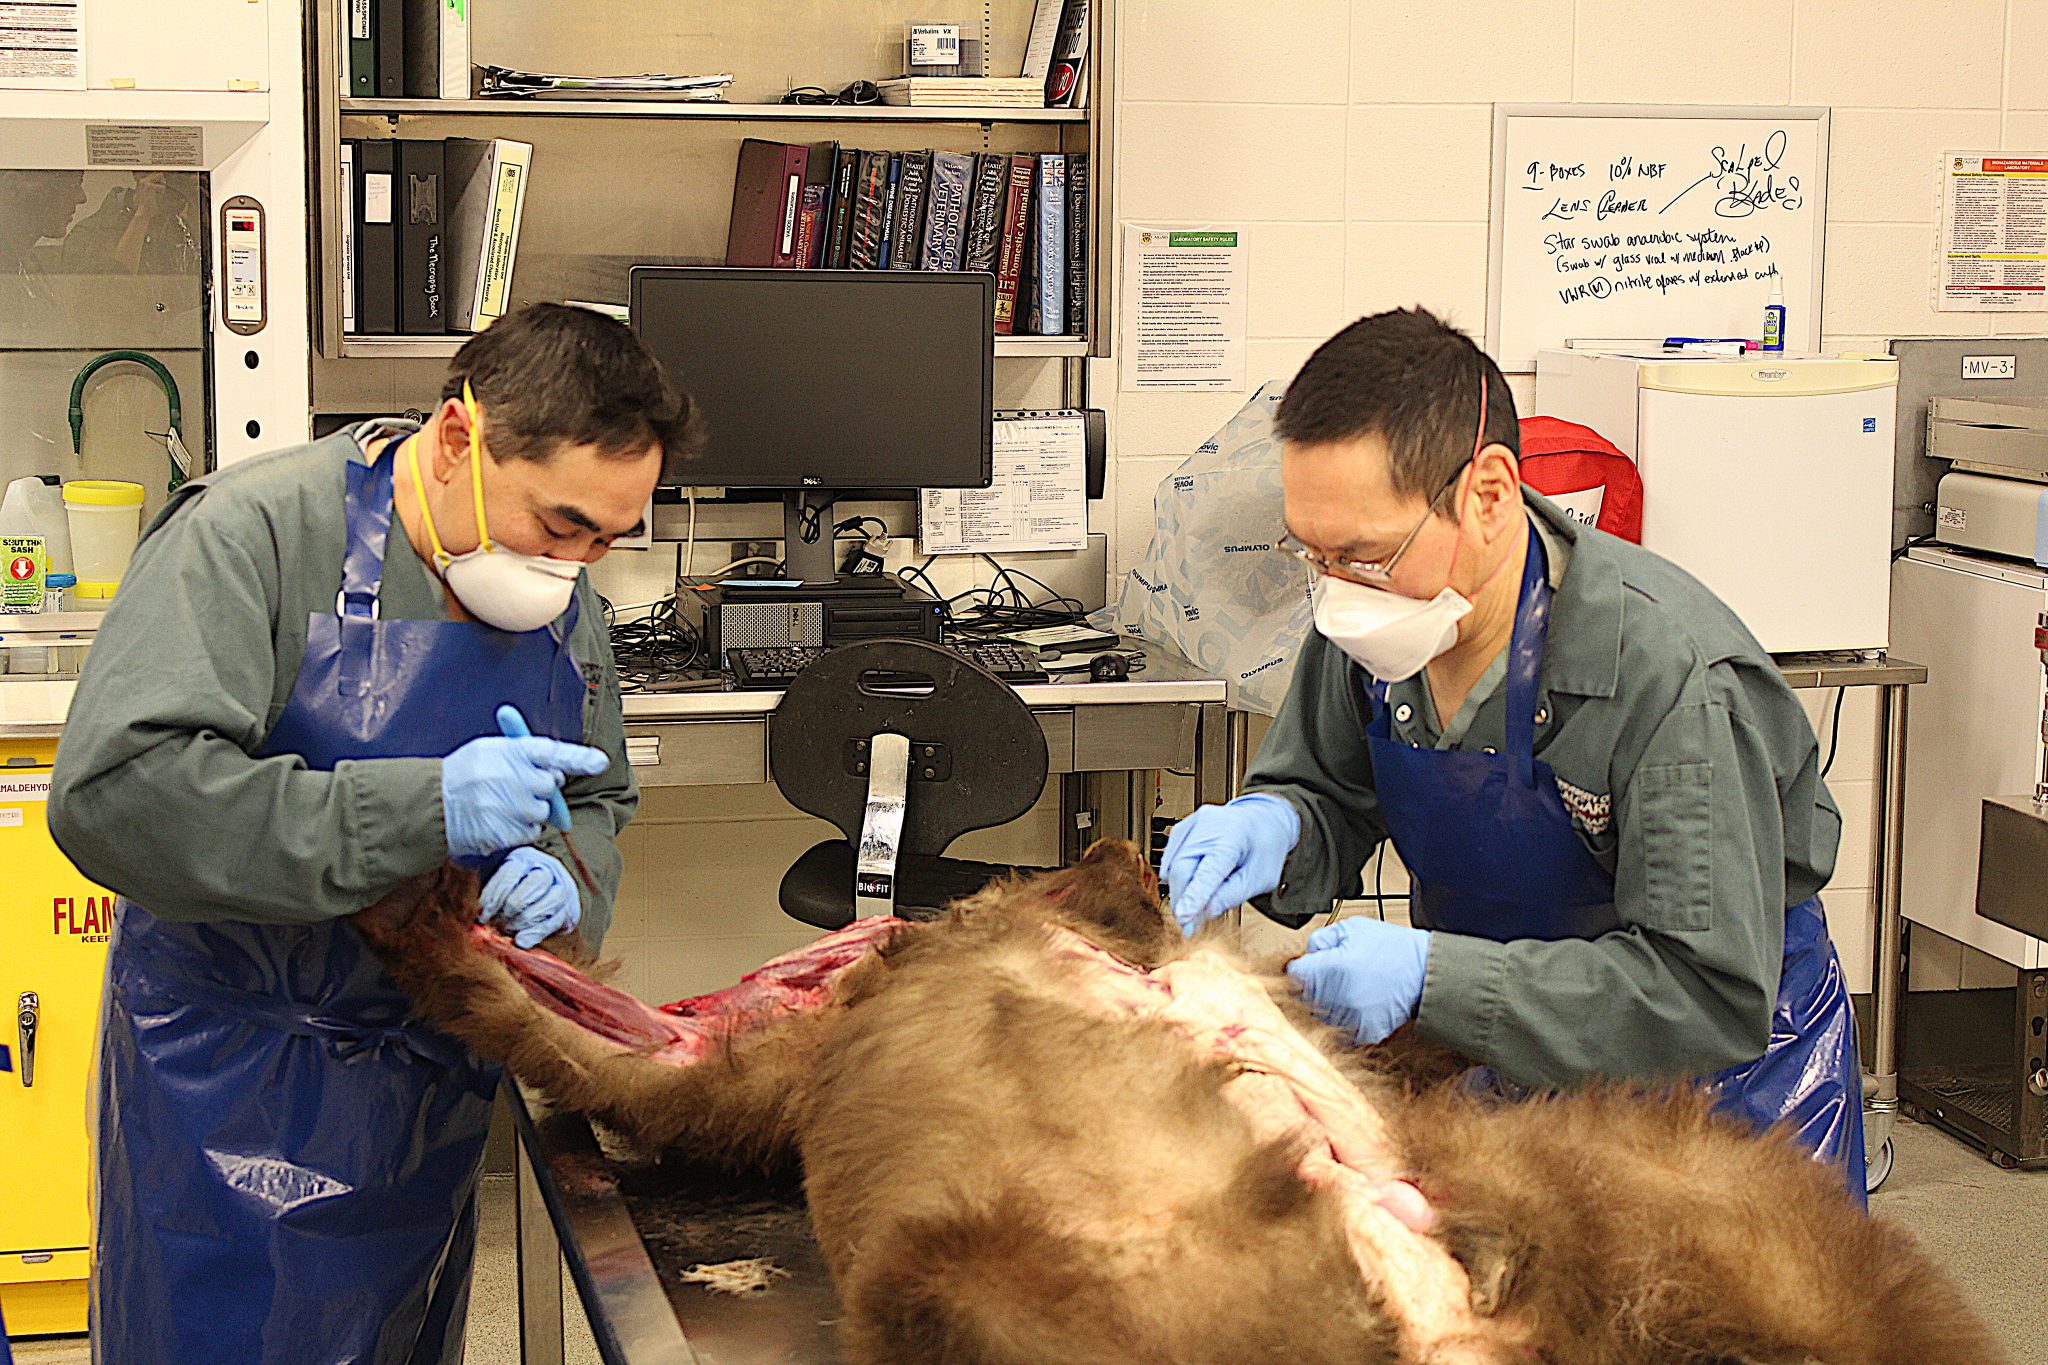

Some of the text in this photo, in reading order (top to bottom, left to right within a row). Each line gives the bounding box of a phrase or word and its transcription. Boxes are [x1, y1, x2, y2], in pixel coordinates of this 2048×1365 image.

[1609, 156, 1632, 181] 10%
[1638, 163, 1667, 178] NBF
[901, 194, 911, 229] DOMESTIC
[907, 195, 918, 234] PATHOLOGY
[931, 182, 950, 254] VETERINARY
[943, 183, 962, 259] PATHOLOGIC
[884, 220, 892, 241] MANUAL
[1010, 231, 1024, 277] Domestic
[1017, 188, 1030, 230] Animals
[1543, 231, 1576, 254] Star
[1581, 233, 1620, 249] swab
[897, 229, 906, 258] ANIMALS
[1000, 242, 1011, 276] Anatomy
[1613, 253, 1641, 272] glass
[424, 235, 439, 318] The Necropsy Book
[1614, 274, 1653, 292] nitrile
[1969, 361, 2008, 374] MV-3
[1224, 543, 1270, 553] OLYMPUS
[1240, 657, 1284, 679] OLYMPUS
[0, 783, 51, 793] MALDEHYD
